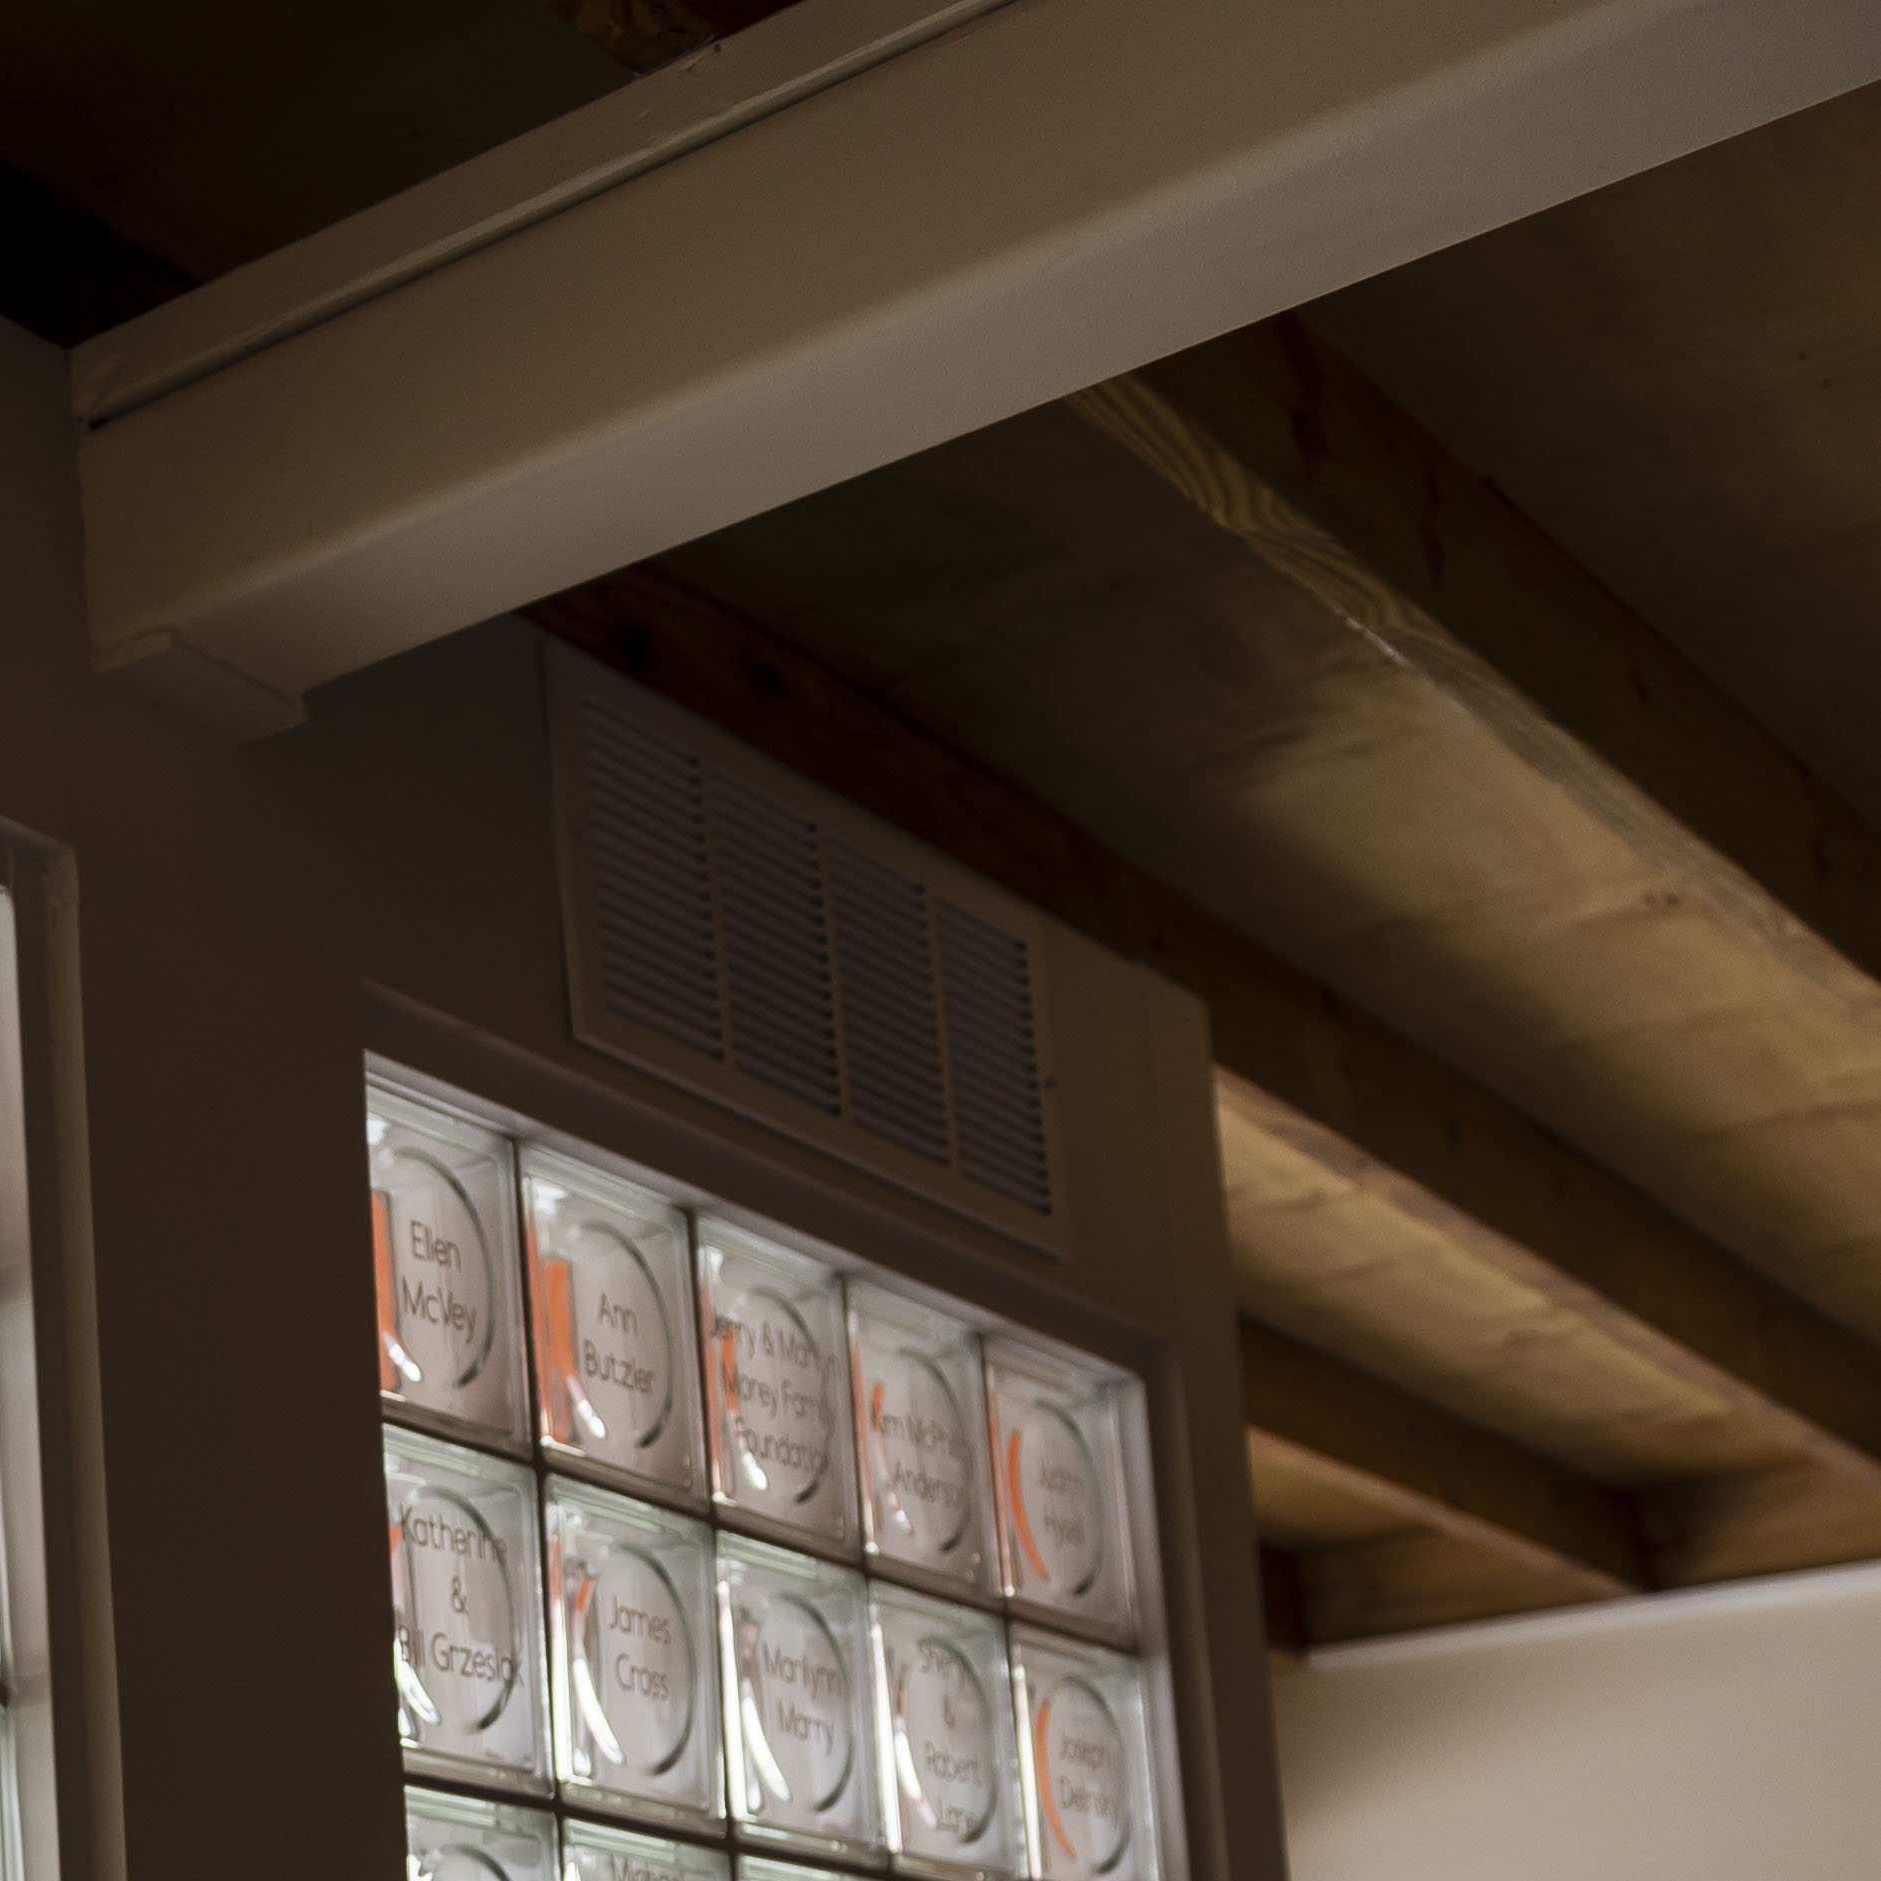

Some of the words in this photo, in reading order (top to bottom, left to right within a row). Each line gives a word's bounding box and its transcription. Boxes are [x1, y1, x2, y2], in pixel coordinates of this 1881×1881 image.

[411, 1220, 461, 1271] Ellen
[402, 1277, 478, 1344] McVey
[599, 1292, 638, 1336] Ann
[450, 1576, 468, 1615] &
[610, 1595, 672, 1645] James
[615, 1652, 669, 1699] Cross
